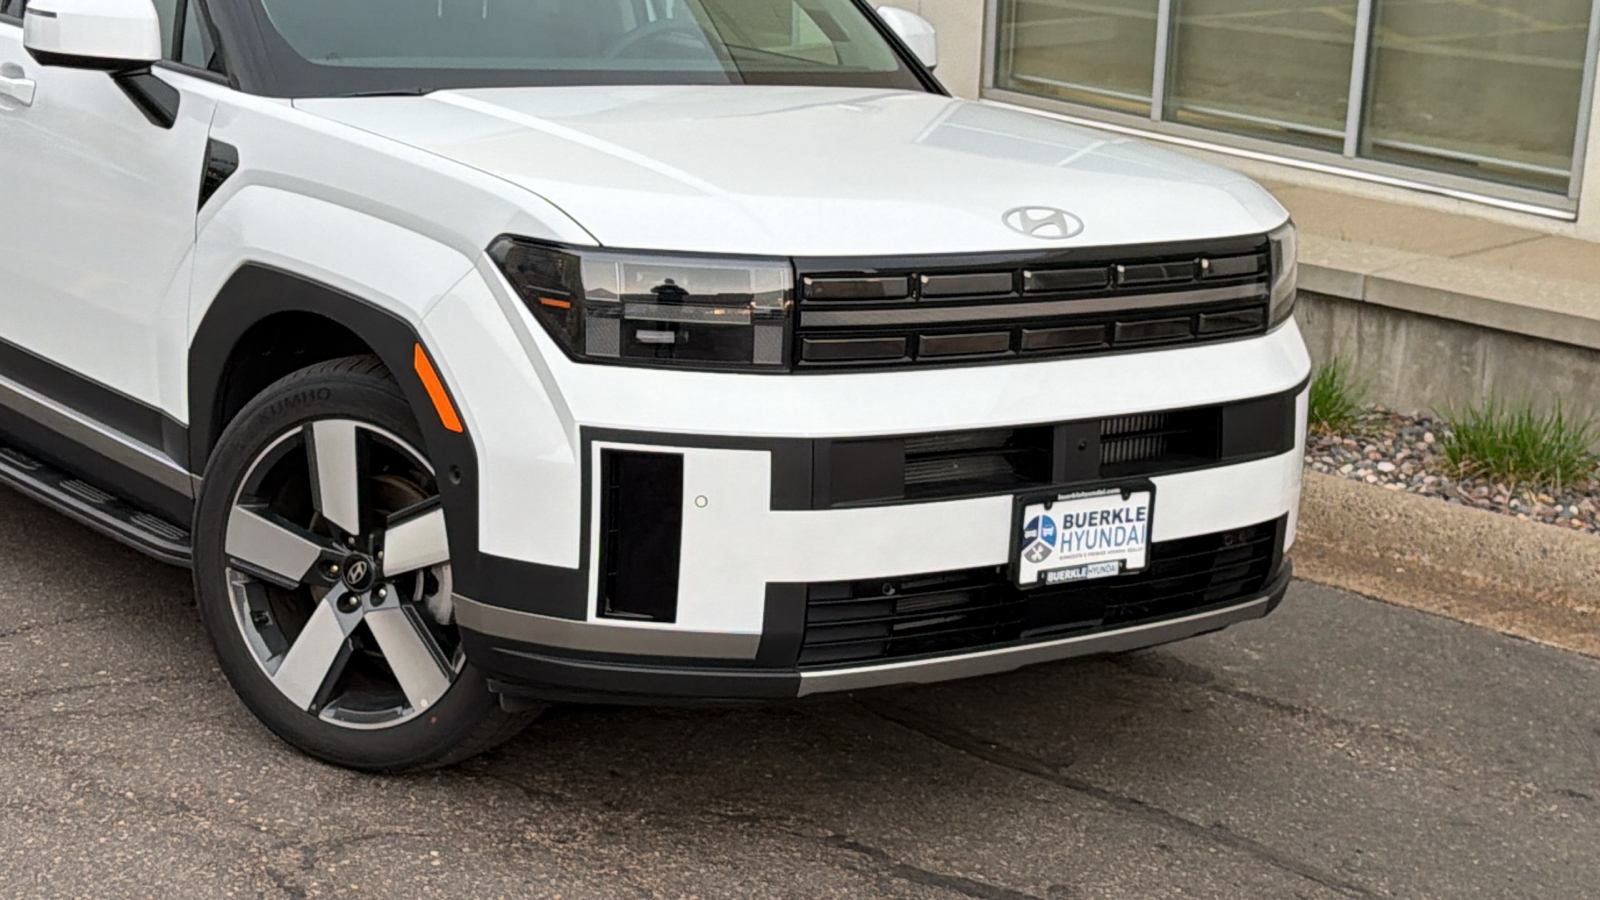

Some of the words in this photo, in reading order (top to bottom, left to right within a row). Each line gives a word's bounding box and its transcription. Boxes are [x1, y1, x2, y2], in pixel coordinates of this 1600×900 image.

[257, 387, 331, 424] KUMHO
[1063, 507, 1146, 530] BUERKLE
[1060, 524, 1146, 553] HYUNDAI
[1047, 567, 1087, 582] BUERKLE
